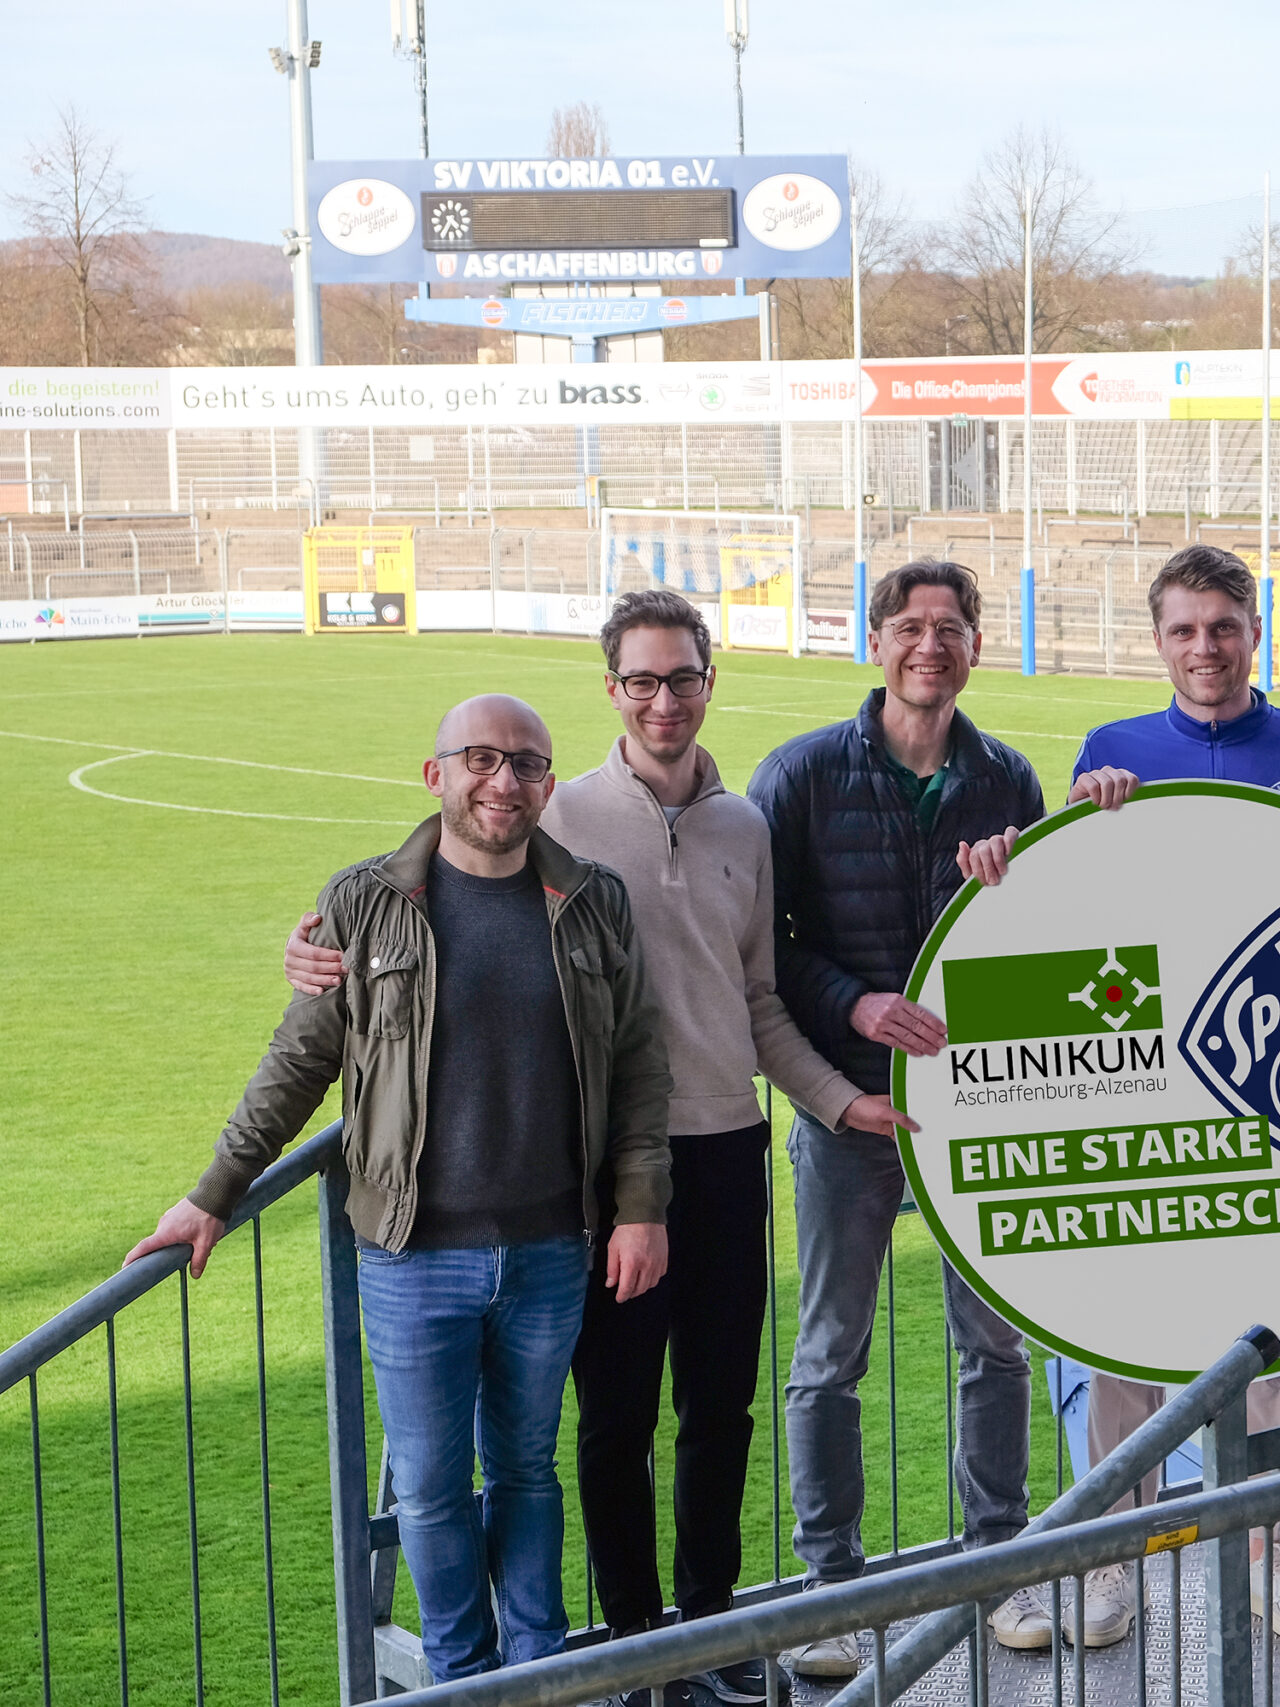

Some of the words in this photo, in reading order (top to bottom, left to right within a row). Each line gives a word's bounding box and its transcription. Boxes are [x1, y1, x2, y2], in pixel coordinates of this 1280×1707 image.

[433, 161, 472, 189] SV
[477, 159, 622, 189] VIKTORIA
[627, 160, 665, 188] 01
[671, 158, 720, 187] e.V.
[463, 251, 696, 278] ASCHAFFENBURG
[520, 302, 648, 323] FISCHER
[8, 378, 38, 397] die
[46, 377, 160, 401] begeistern!
[183, 385, 275, 409] Geht's
[286, 389, 349, 408] ums
[359, 383, 434, 410] Auto,
[517, 387, 548, 406] zu
[788, 381, 857, 401] TOSHIBA
[891, 380, 912, 398] Die
[1099, 391, 1163, 403] INFORMATION
[155, 596, 187, 608] Artur
[950, 1034, 1166, 1085] KLINIKUM
[953, 1074, 1168, 1107] Aschaffenburg-Alzenau
[959, 1136, 1067, 1183] EINE
[1082, 1120, 1264, 1173] STARKE
